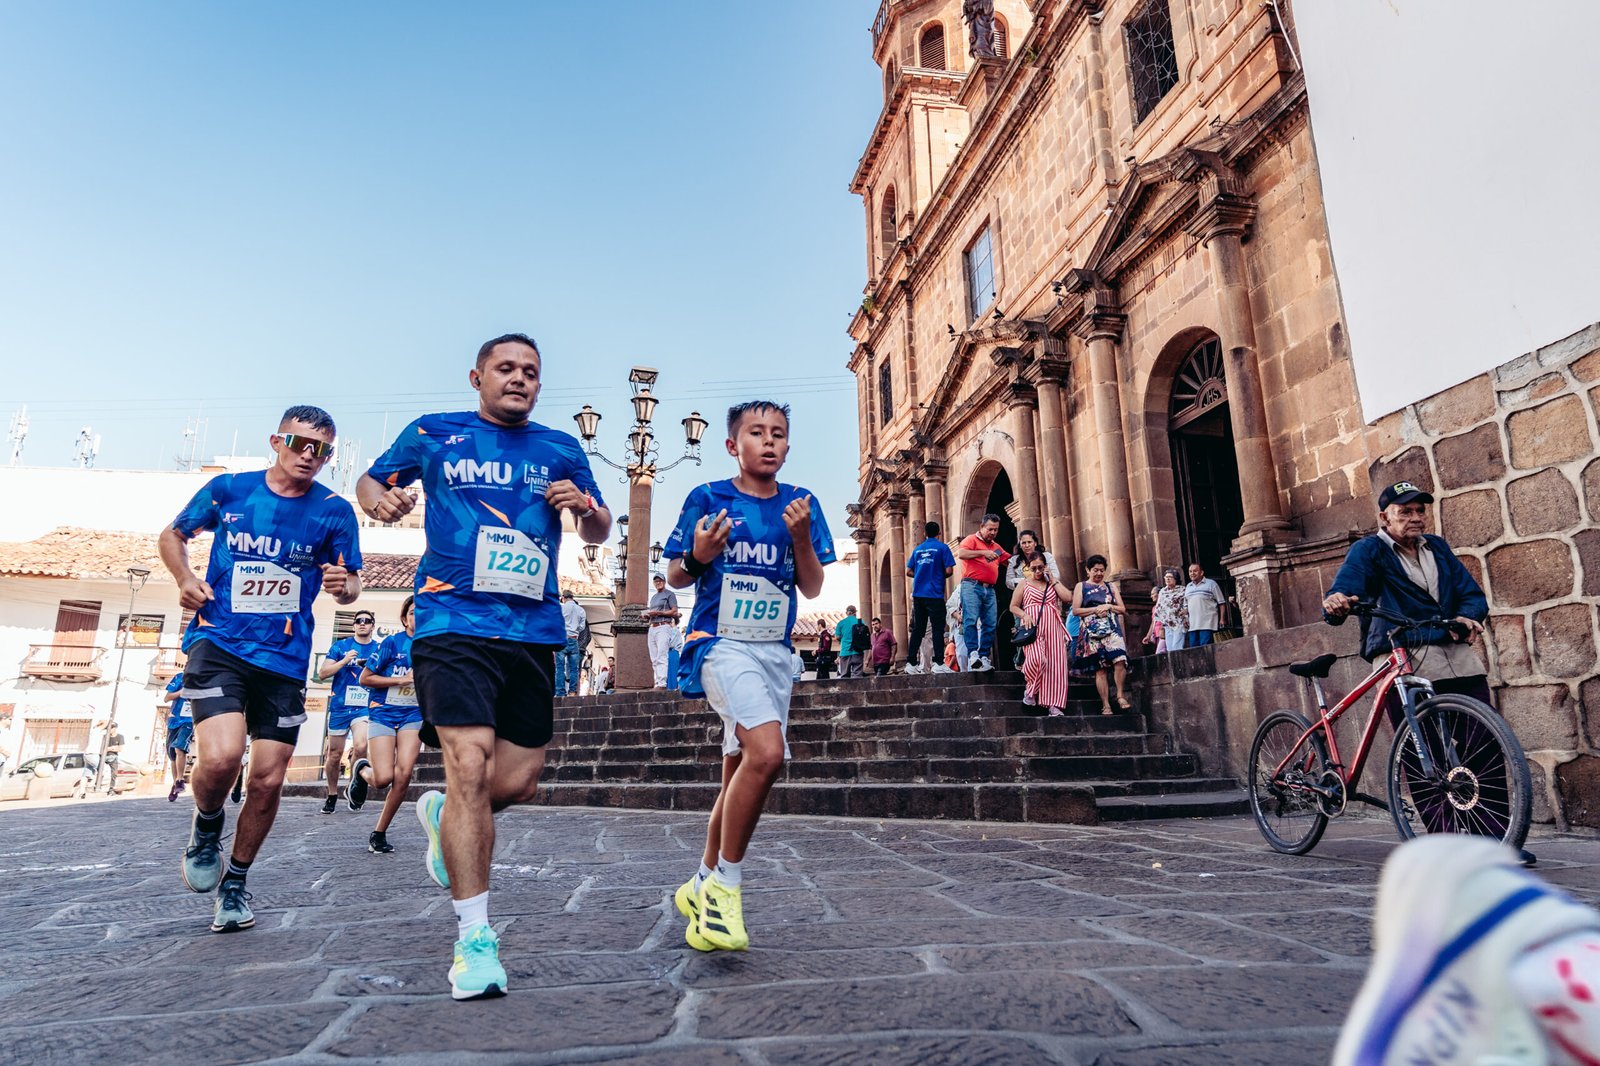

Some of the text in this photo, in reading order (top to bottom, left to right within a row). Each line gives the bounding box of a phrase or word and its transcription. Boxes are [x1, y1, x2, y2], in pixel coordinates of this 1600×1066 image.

[443, 458, 513, 485] MMU
[226, 530, 282, 557] MMU
[486, 532, 515, 545] MMU
[723, 541, 778, 565] MMU
[239, 565, 265, 574] MMU
[487, 550, 541, 577] 1220
[240, 579, 292, 596] 2176
[730, 580, 758, 593] MMU
[733, 598, 782, 620] 1195
[393, 665, 413, 676] MM
[350, 692, 367, 700] 1197
